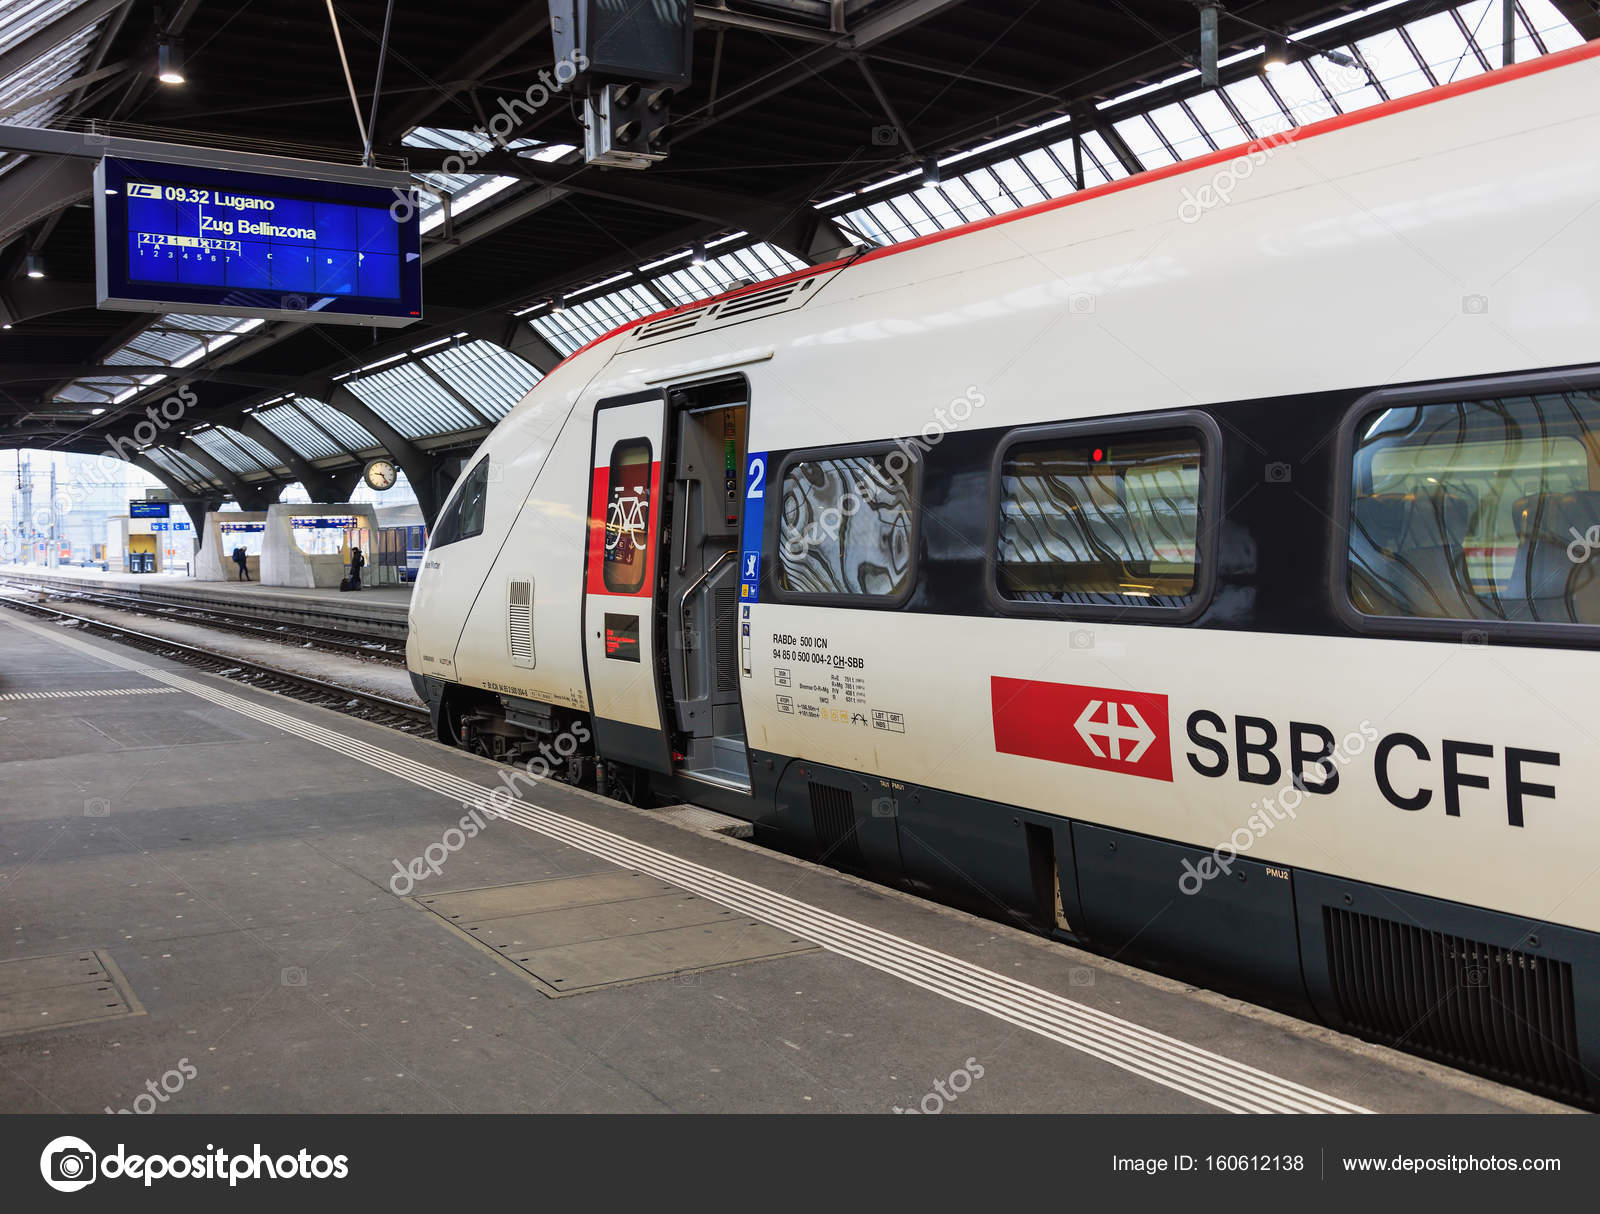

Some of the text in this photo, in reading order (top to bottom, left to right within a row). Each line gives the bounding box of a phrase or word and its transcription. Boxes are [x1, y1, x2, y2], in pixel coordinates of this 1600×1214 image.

[165, 186, 210, 204] 09.32
[214, 191, 275, 211] Lugano
[201, 216, 317, 240] Zug Bellinzona
[747, 458, 765, 499] 2
[773, 633, 828, 649] RABDe 500 ICN
[772, 648, 864, 669] 94 85 0 500 004-2 CH-SBB
[1186, 709, 1561, 828] SBB CFF
[1265, 867, 1289, 880] PMU2
